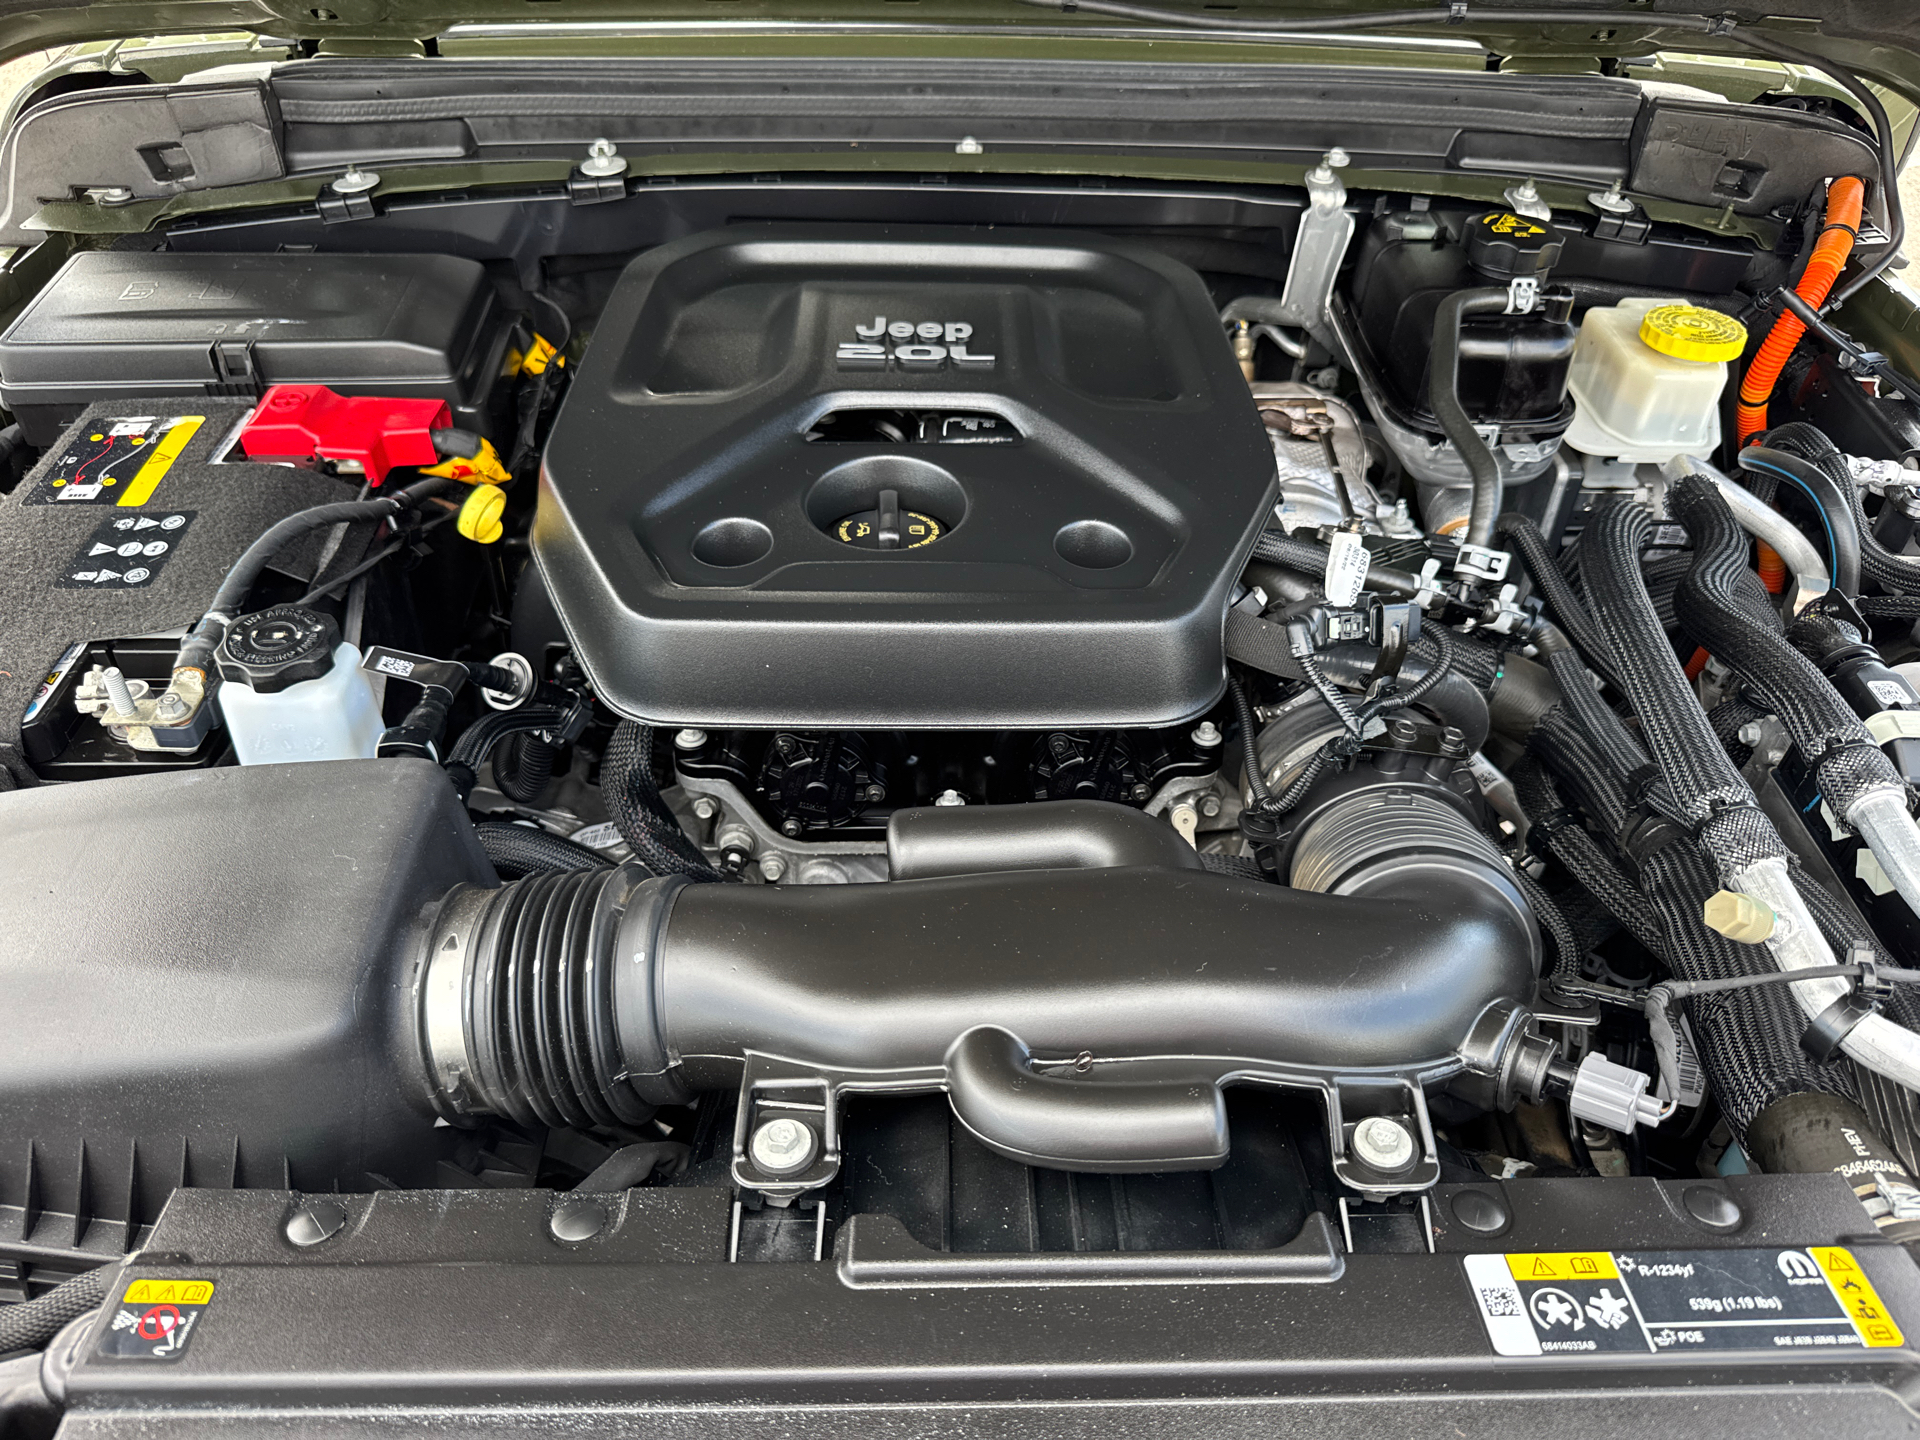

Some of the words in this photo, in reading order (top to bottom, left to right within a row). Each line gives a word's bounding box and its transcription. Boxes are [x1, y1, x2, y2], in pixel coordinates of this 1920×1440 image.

[855, 316, 973, 342] Jeep
[836, 343, 995, 366] 2.0L
[1840, 1127, 1871, 1157] PHEV
[1637, 1263, 1695, 1279] R-1234yf
[1689, 1297, 1723, 1313] 539g
[1722, 1296, 1755, 1312] (1.19
[1754, 1296, 1783, 1311] lbs)
[1677, 1330, 1705, 1343] POE
[1541, 1340, 1597, 1351] 68414033AB
